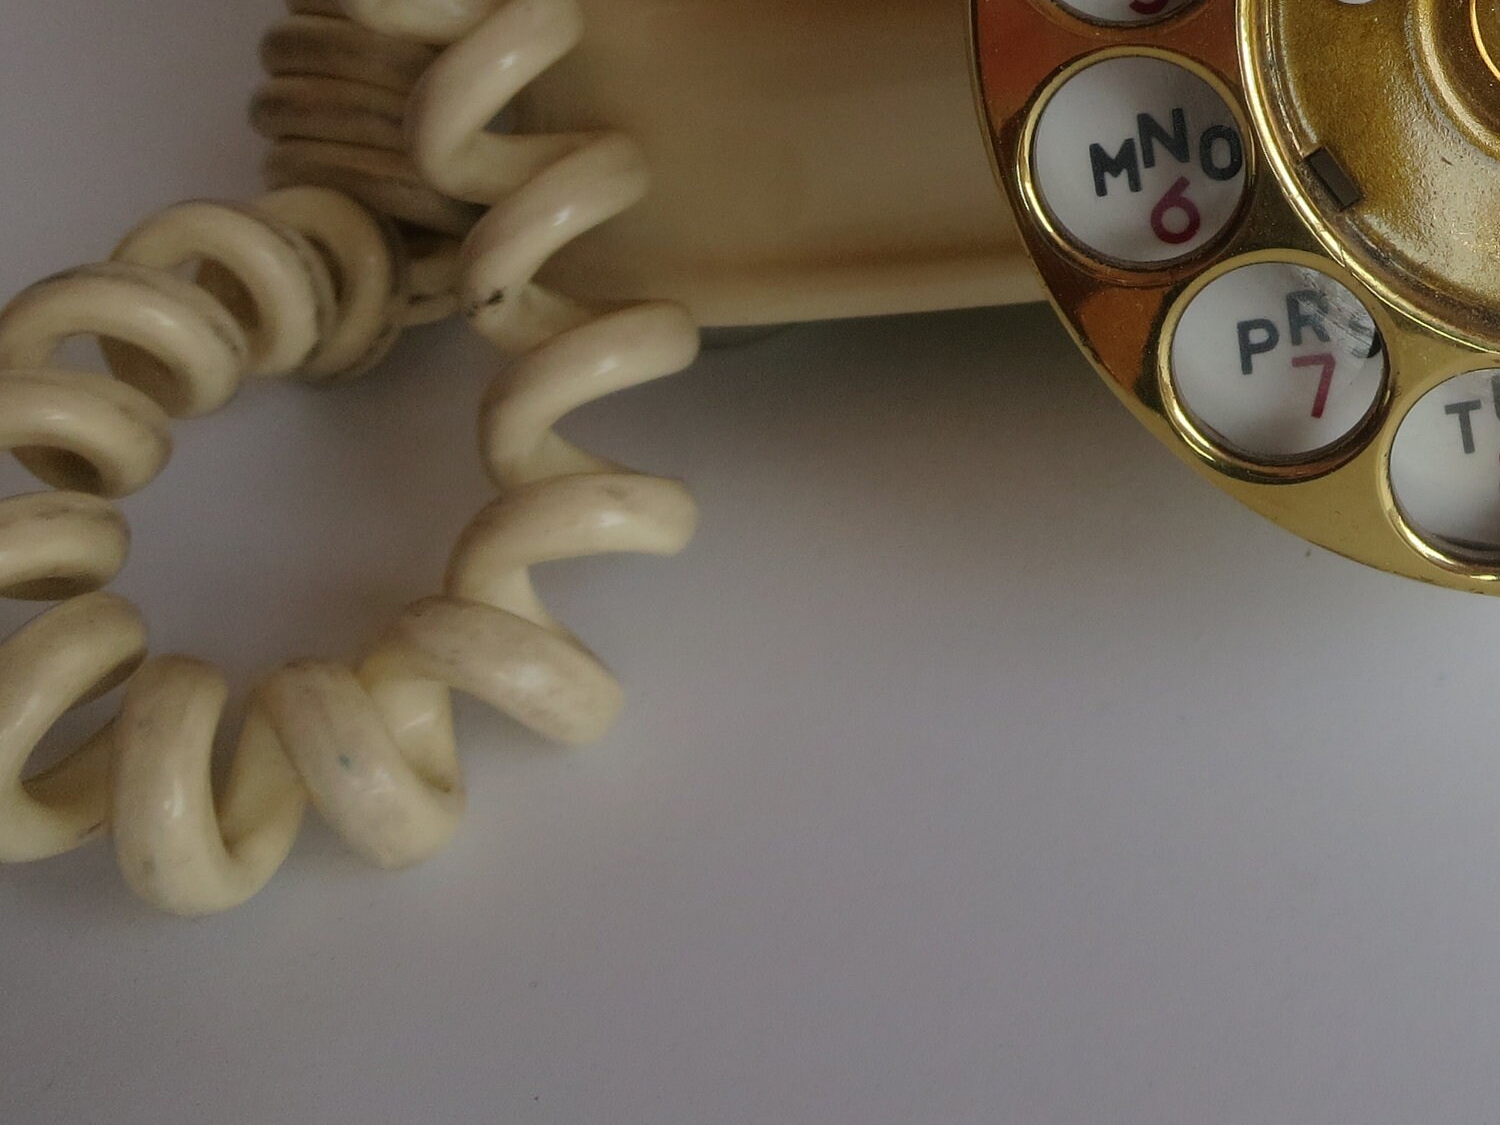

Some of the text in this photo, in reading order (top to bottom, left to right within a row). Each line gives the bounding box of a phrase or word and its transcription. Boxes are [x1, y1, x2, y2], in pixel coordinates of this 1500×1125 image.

[1089, 108, 1243, 198] MNO
[1151, 176, 1200, 244] 6
[1292, 353, 1336, 418] 7
